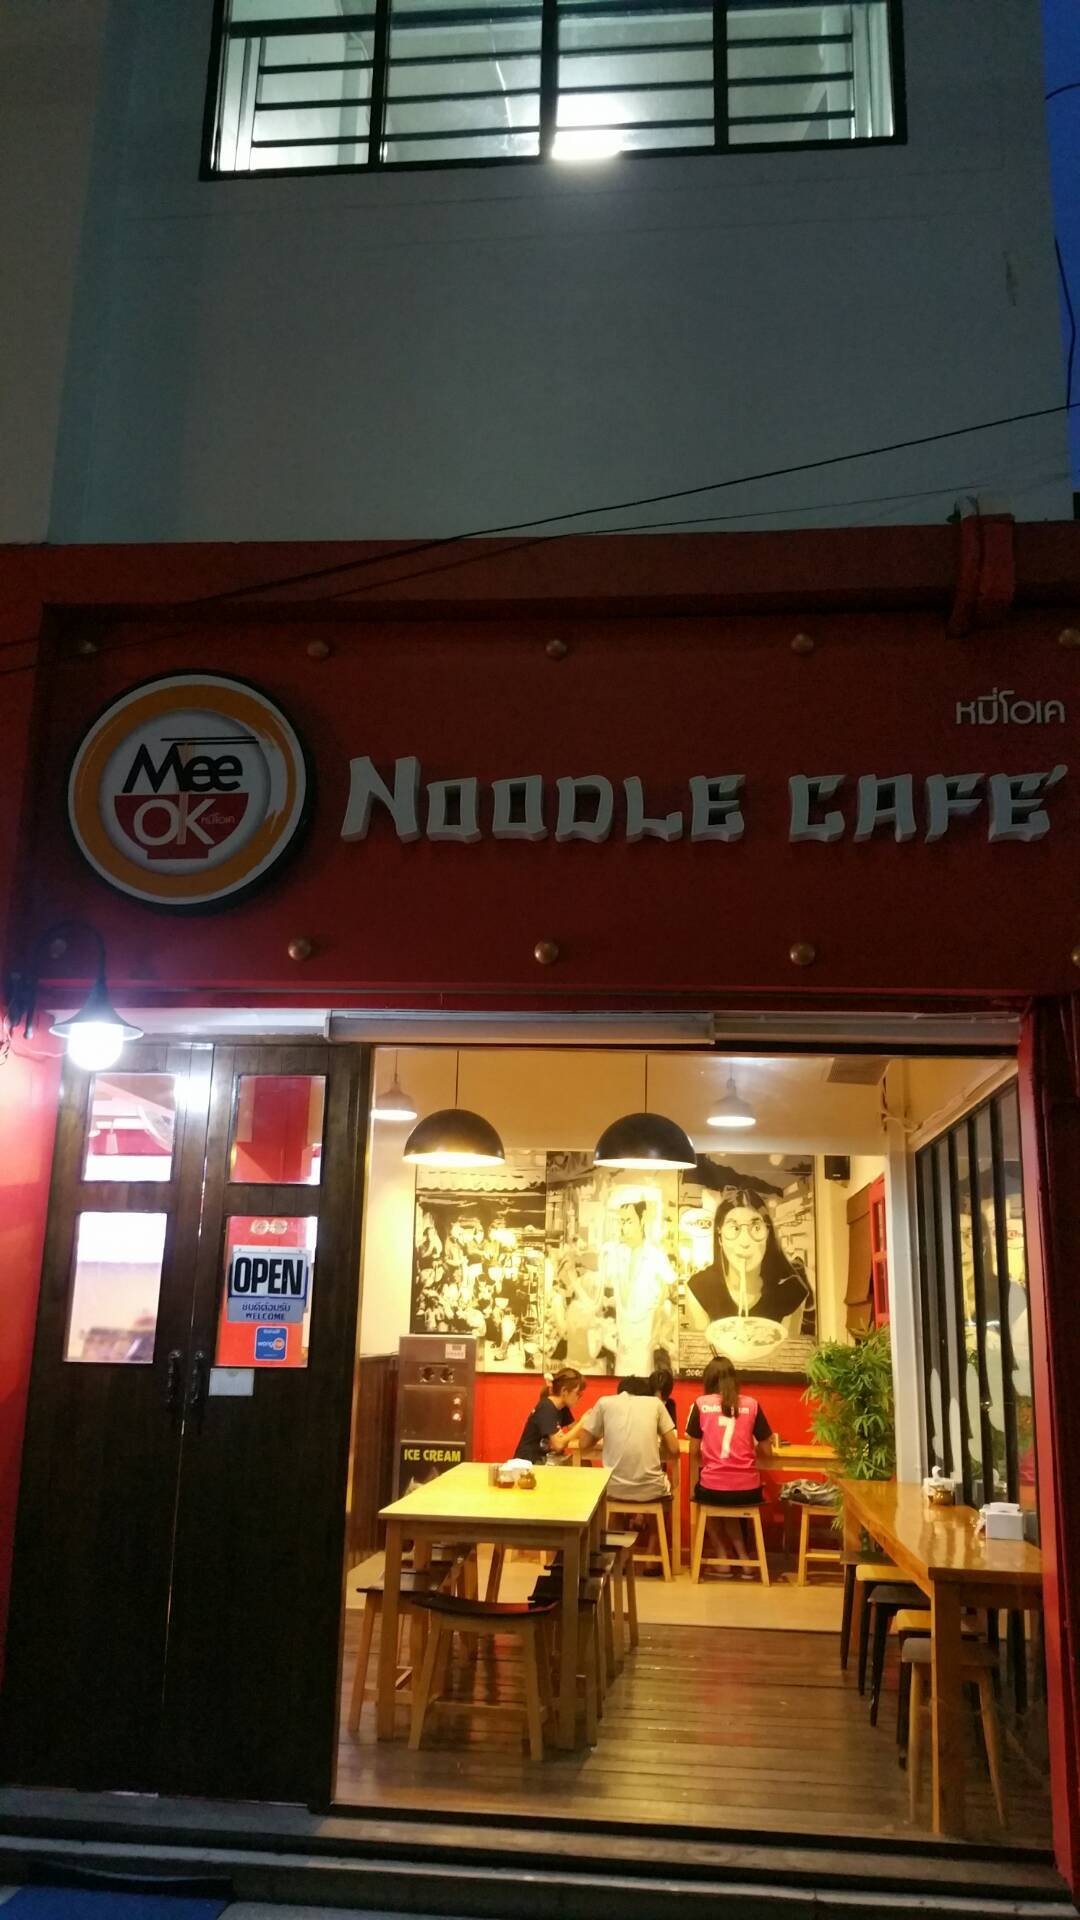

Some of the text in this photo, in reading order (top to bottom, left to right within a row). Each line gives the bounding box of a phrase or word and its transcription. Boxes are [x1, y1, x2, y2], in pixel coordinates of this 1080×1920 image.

[954, 687, 1066, 725] หมี่โอเค
[122, 743, 244, 794] Mee
[340, 755, 746, 844] NOODLE
[133, 798, 217, 847] OK
[233, 1257, 304, 1296] OPEN
[245, 1312, 286, 1321] WELCOME
[404, 1448, 461, 1462] ICE CREAM
[718, 1415, 736, 1459] 7
